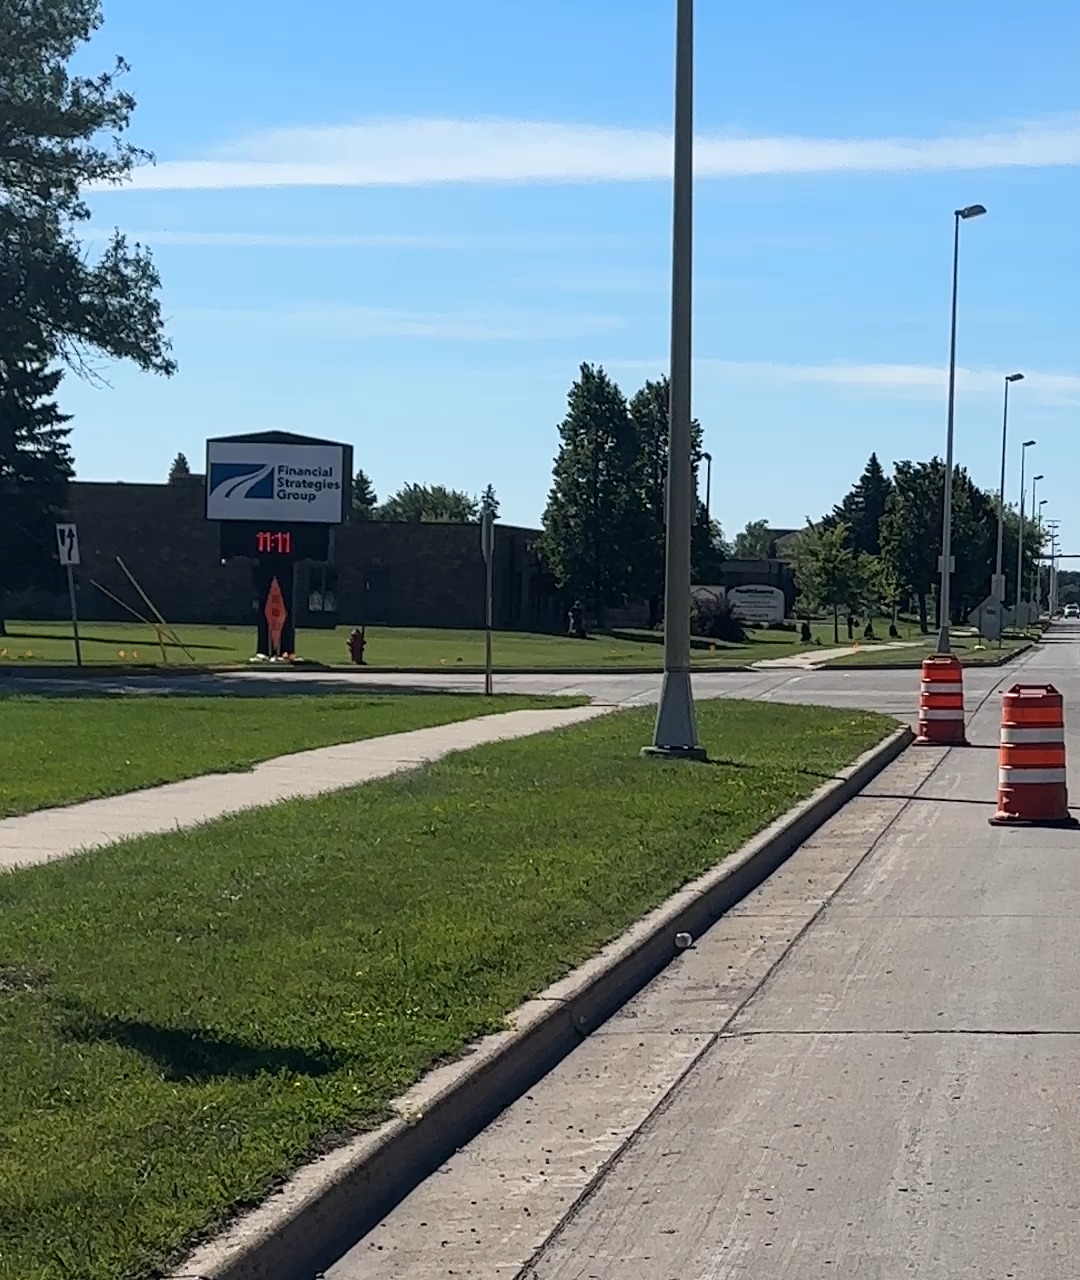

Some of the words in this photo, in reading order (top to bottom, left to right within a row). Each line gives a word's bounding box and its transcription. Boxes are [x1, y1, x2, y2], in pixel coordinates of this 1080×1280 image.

[277, 463, 333, 478] Financial
[276, 476, 341, 493] Strategies
[276, 489, 317, 503] Group
[255, 531, 292, 554] 11:11
